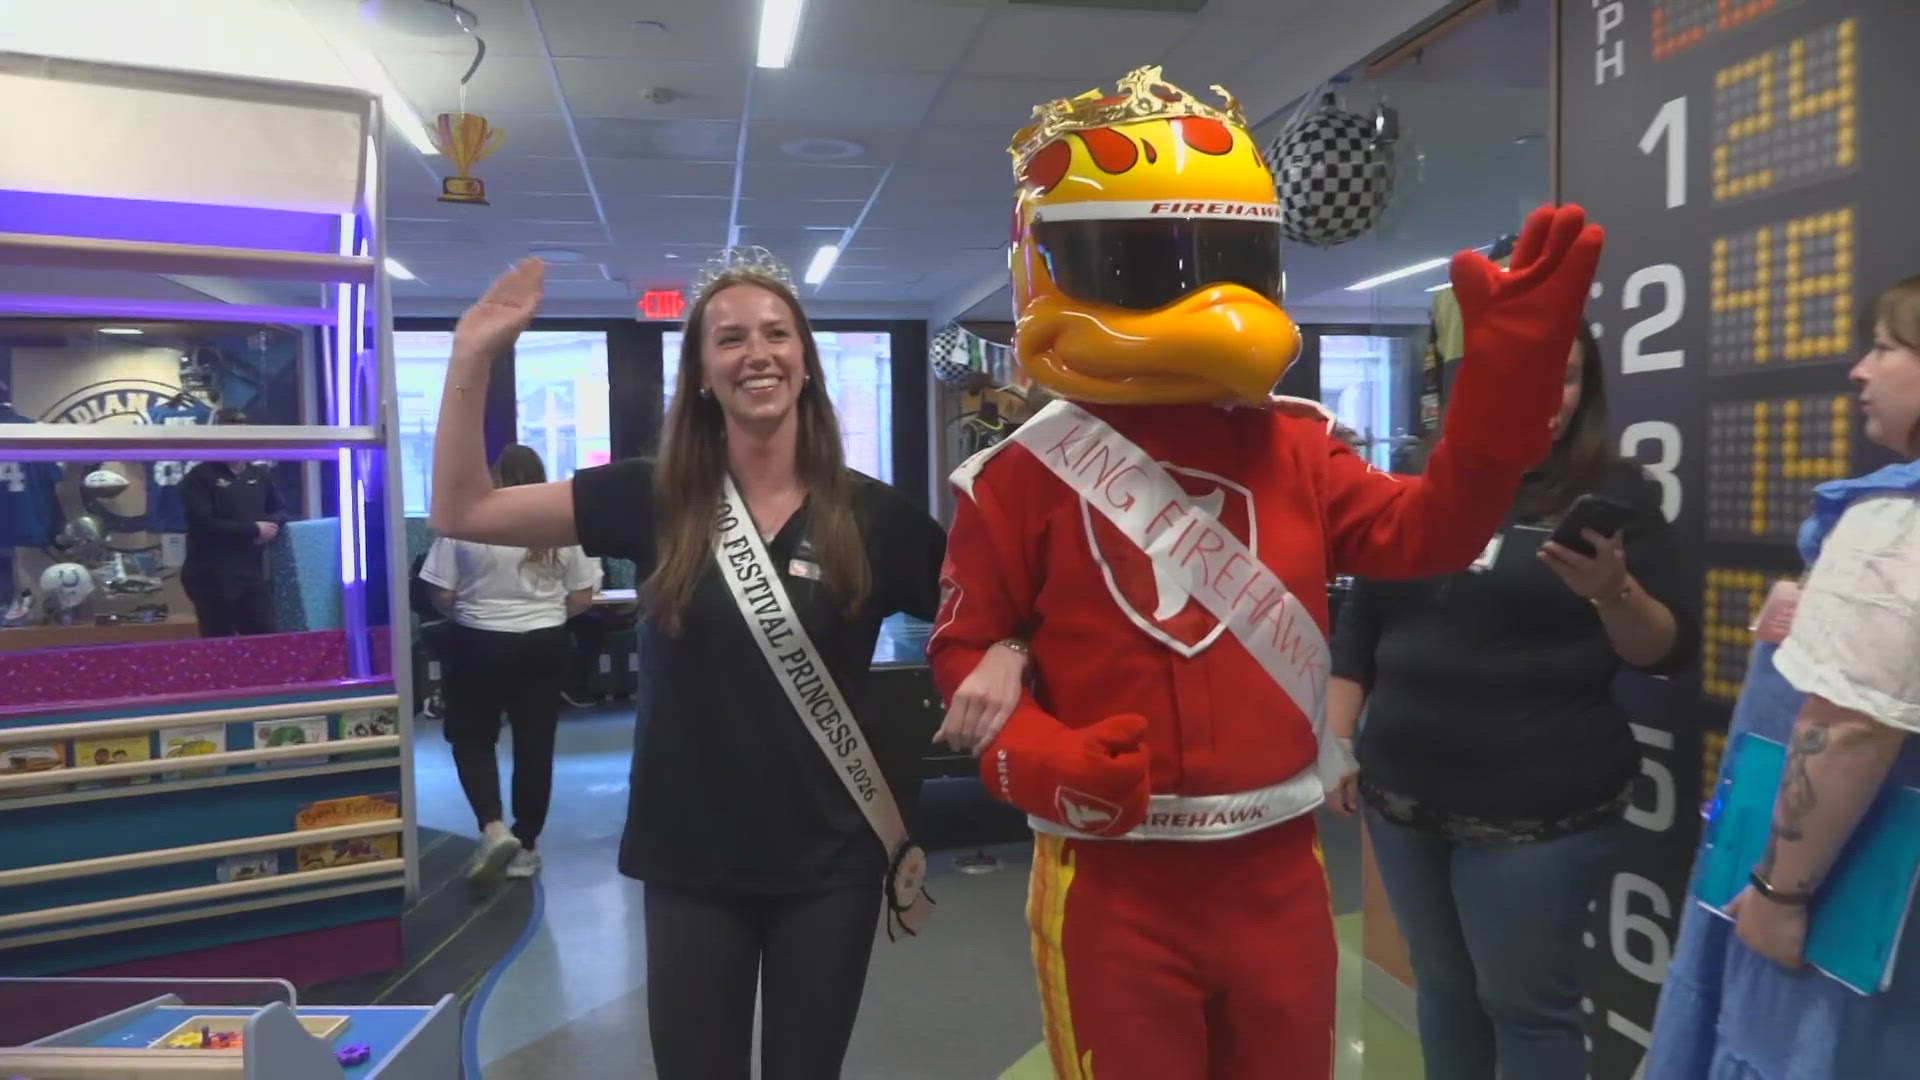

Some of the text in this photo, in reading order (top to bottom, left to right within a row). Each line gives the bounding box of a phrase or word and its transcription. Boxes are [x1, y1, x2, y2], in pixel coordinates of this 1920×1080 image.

[1591, 0, 1624, 86] PH
[1638, 95, 1687, 209] 1
[1713, 18, 1856, 202] 24
[644, 290, 681, 318] EXIT
[1621, 208, 1854, 375] 2 48
[1620, 397, 1851, 536] 3 14
[1046, 425, 1324, 700] KING FIREHAWK
[714, 503, 877, 803] 00 FESTIVAL PRINCESS 2026
[1141, 805, 1264, 828] IREHAWK
[1610, 872, 1671, 984] 6
